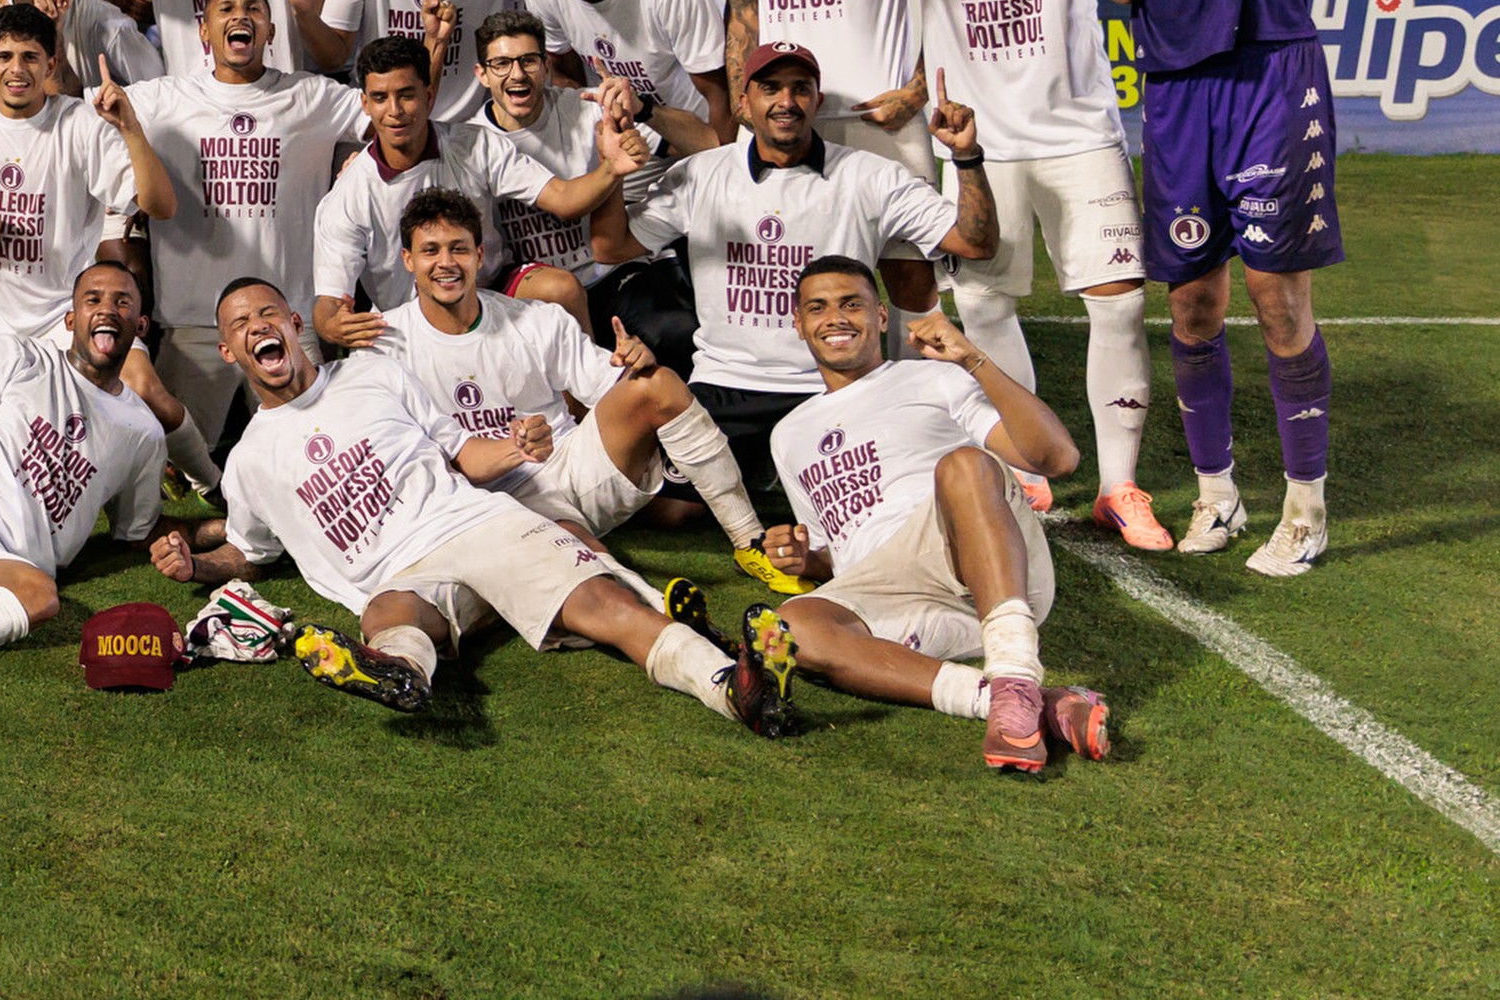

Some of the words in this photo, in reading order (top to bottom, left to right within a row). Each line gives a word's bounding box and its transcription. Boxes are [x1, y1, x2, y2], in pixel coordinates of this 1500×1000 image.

[200, 136, 281, 159] MOLEQUE
[201, 159, 280, 181] TRAVESSO
[202, 181, 277, 206] VOLTOU!
[726, 240, 814, 268] MOLEQUE
[727, 264, 802, 290] TRAVESS
[295, 436, 377, 509] MOLEQUE
[798, 439, 880, 493] MOLEQUE
[311, 457, 386, 529] TRAVESSO
[324, 476, 395, 553] VOLTOU!
[97, 634, 163, 658] MOOCA
